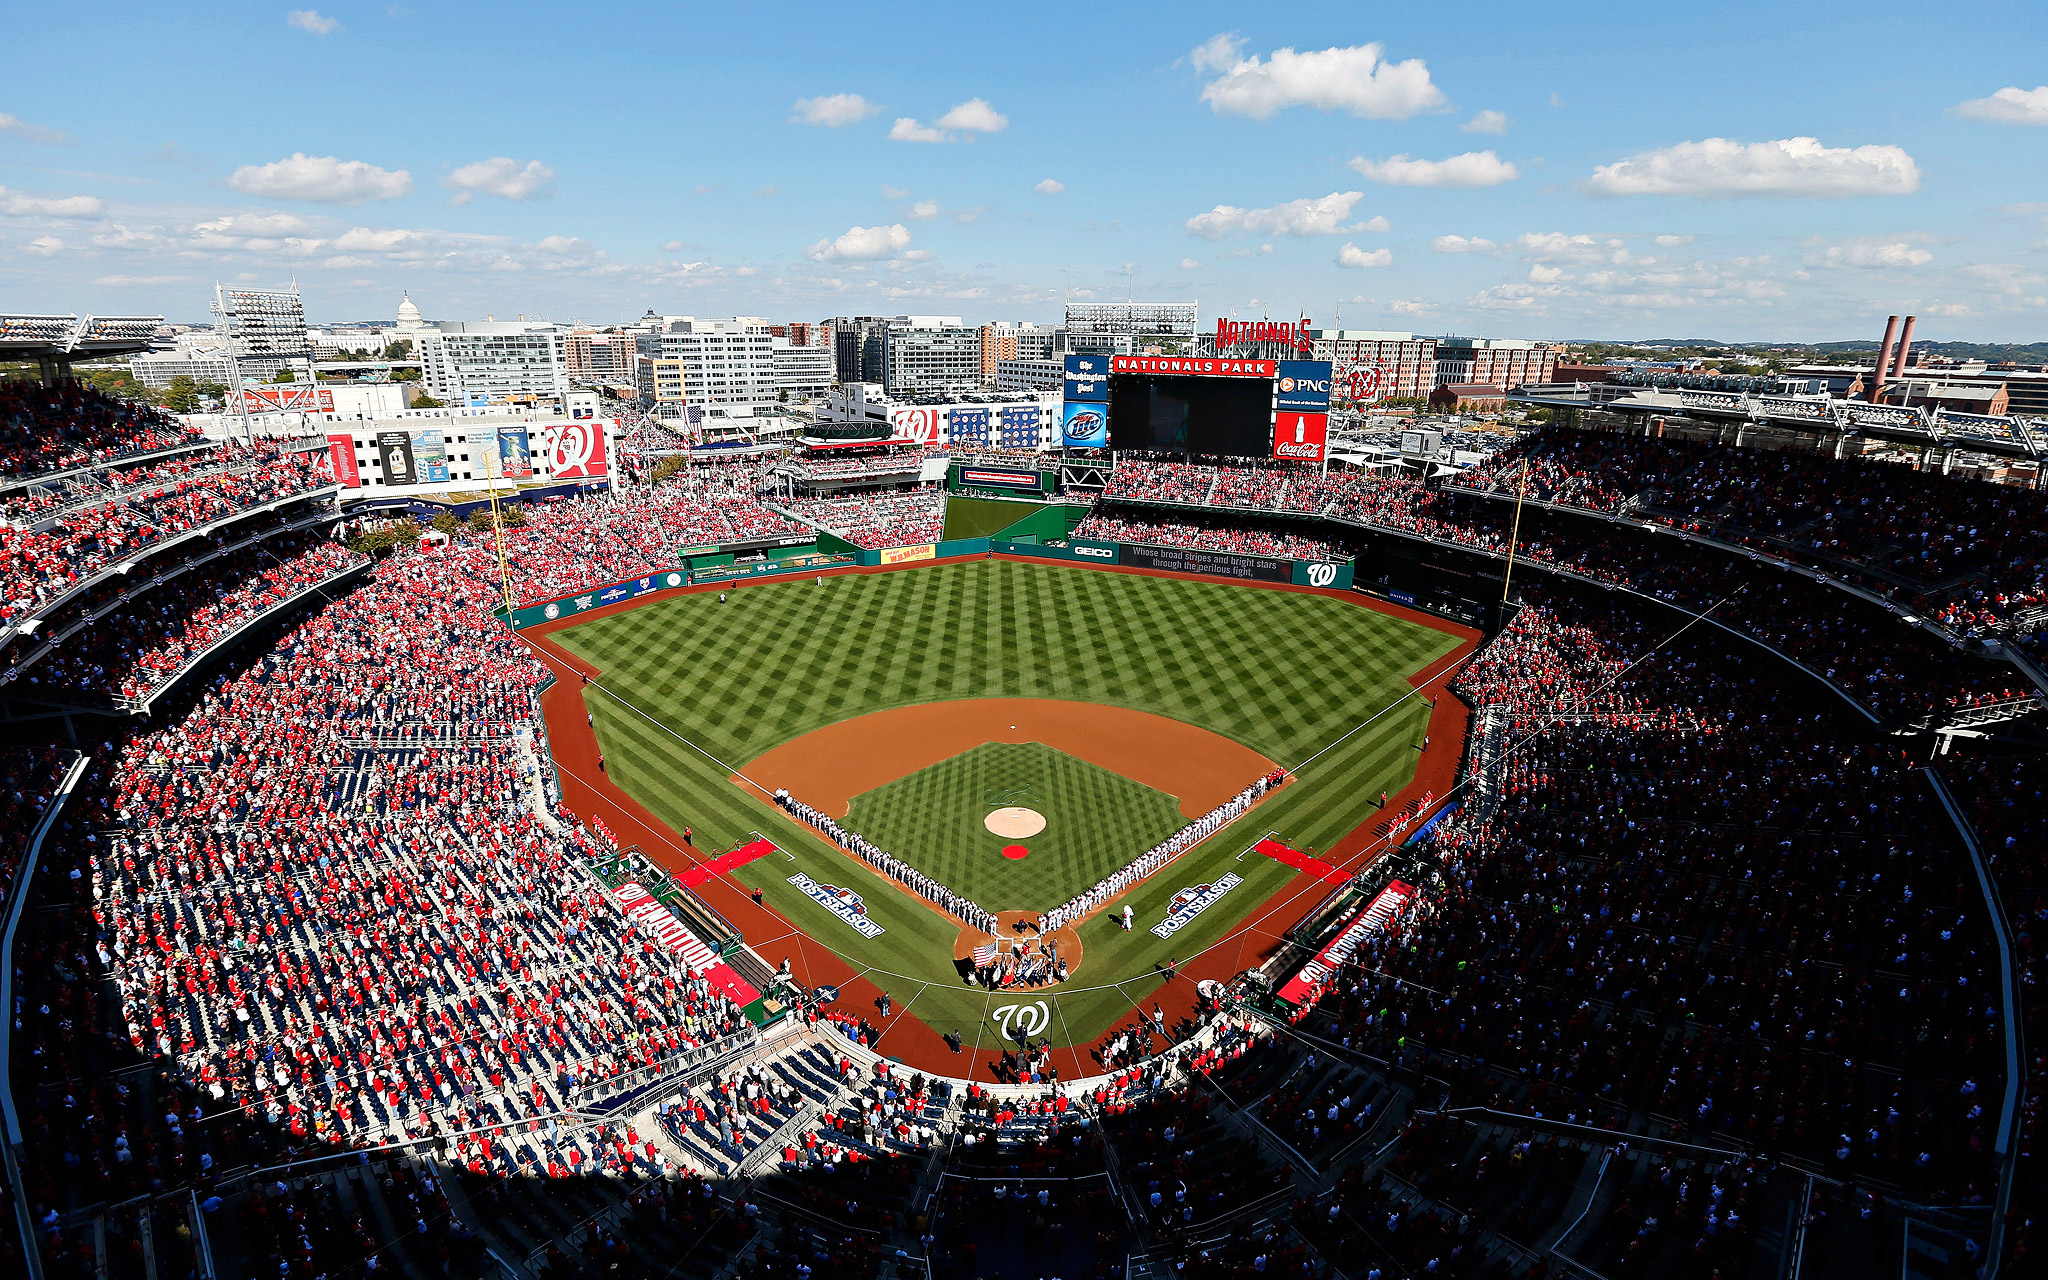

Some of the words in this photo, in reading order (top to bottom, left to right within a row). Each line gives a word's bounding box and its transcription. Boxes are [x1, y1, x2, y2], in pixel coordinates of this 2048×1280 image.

[1216, 318, 1311, 351] NATIONALS
[1065, 370, 1107, 383] Washington
[1079, 361, 1094, 371] The
[1118, 360, 1213, 372] NATIONALS
[1221, 362, 1265, 373] PARK
[1077, 383, 1094, 394] Post
[1297, 379, 1328, 393] PNC
[1072, 419, 1100, 436] Lite
[1074, 546, 1113, 558] GEICO
[1132, 546, 1159, 557] Whose
[1161, 549, 1183, 560] broad
[1185, 551, 1212, 565] stripes
[1213, 555, 1229, 565] and
[1230, 556, 1255, 568] bright
[1256, 560, 1277, 570] stars
[1152, 558, 1182, 570] through
[1184, 561, 1197, 571] the
[1199, 563, 1231, 576] perilous
[1232, 565, 1253, 578] fight,
[1307, 563, 1337, 587] W
[787, 873, 885, 938] POSTSEASON
[1151, 873, 1243, 938] POSTSEASON
[1358, 888, 1407, 931] NATITUDE
[630, 901, 725, 978] #NATITUDE
[1323, 924, 1371, 965] OCTOBER
[992, 1000, 1050, 1041] W
